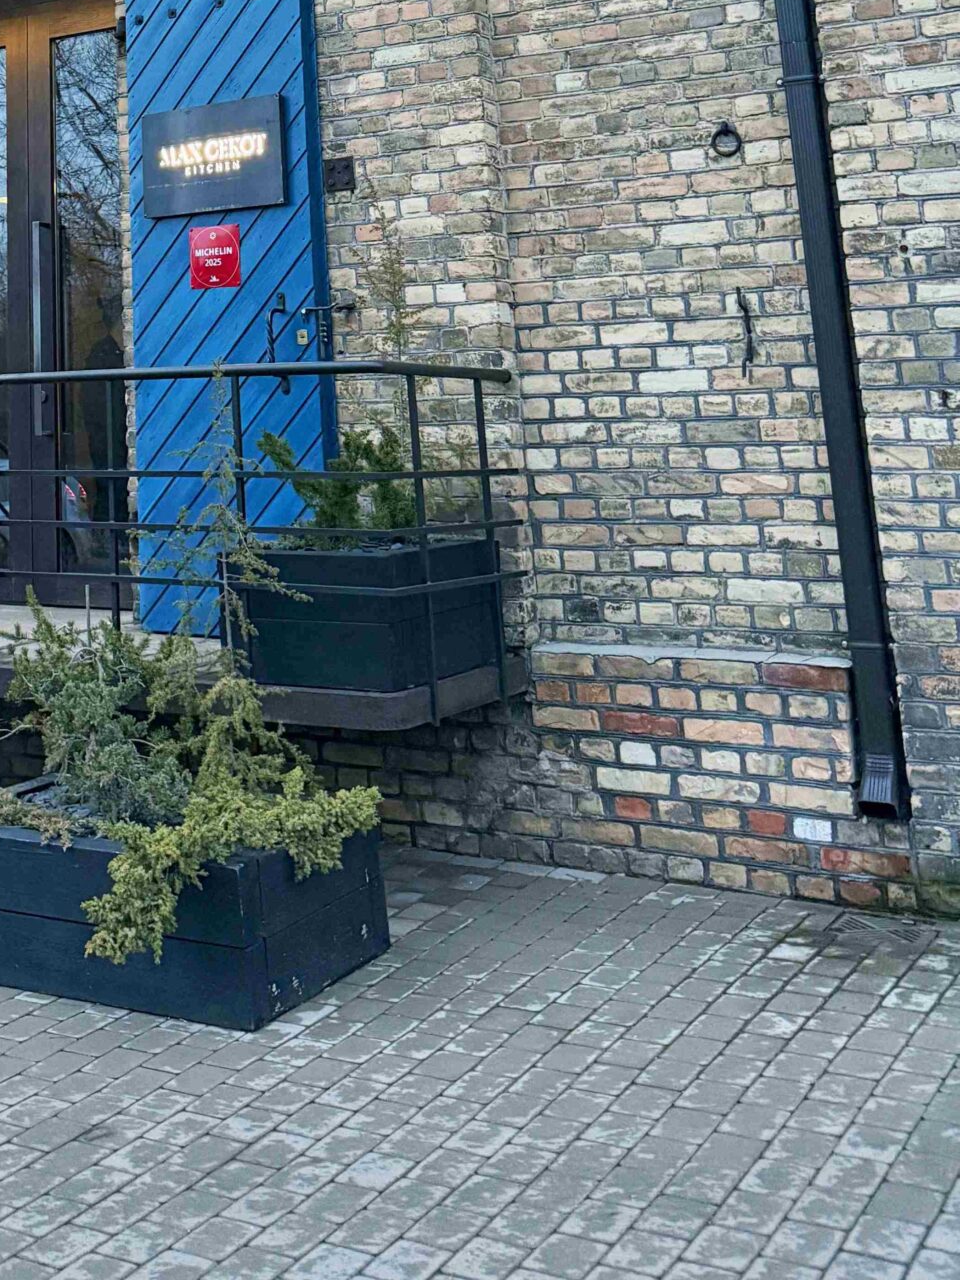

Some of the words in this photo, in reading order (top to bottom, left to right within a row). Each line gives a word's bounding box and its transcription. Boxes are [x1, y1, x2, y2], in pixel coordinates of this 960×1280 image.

[159, 141, 203, 167] MAX
[185, 160, 241, 177] KITCHEN
[195, 247, 232, 257] MICHELIN
[205, 258, 222, 267] 2025
